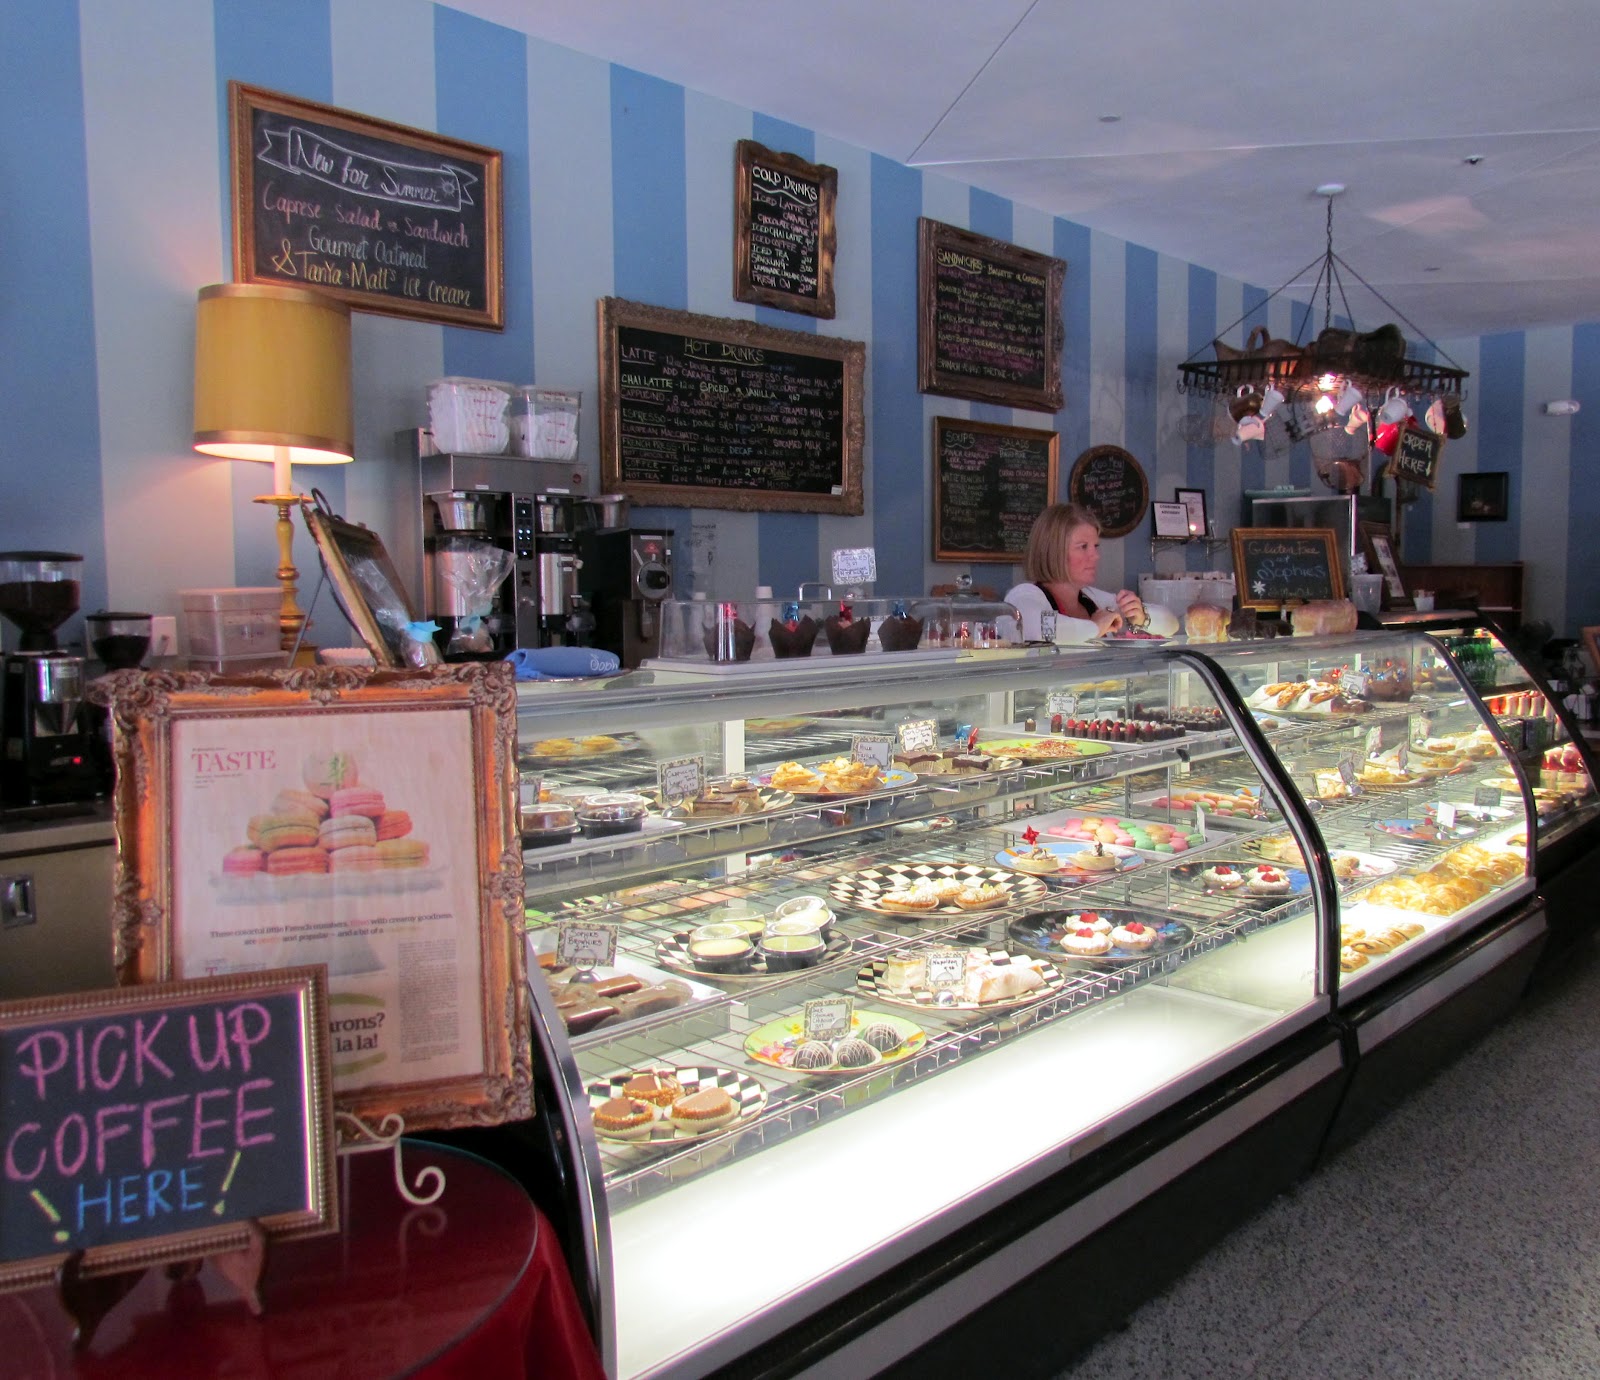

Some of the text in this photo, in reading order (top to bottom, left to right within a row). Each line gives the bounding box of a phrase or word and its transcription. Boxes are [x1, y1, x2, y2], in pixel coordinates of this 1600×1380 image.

[296, 135, 441, 203] New for Summer
[752, 165, 819, 202] COLD DRINKS
[752, 191, 777, 207] ICED
[779, 196, 806, 214] LATTE
[263, 181, 322, 225] Caprese
[336, 205, 383, 232] Salad
[404, 217, 470, 248] Sandwich
[752, 222, 803, 245] ICED CHAI LATTE
[752, 233, 771, 246] ICED
[771, 239, 798, 254] COFFEE
[309, 225, 429, 270] Gourmet Oatmeal
[752, 243, 772, 256] ICED
[775, 248, 790, 262] TEA
[752, 270, 777, 288] FRESH
[428, 280, 471, 307] Cream
[684, 338, 765, 364] HOT DRINKS
[621, 344, 657, 362] LATTE
[719, 366, 737, 377] SHOT
[741, 369, 781, 384] ESPRESSO
[662, 367, 679, 377] ADD
[681, 369, 718, 384] CARAMEL
[621, 374, 643, 387] CHAI
[644, 377, 673, 390] LATTE
[699, 380, 730, 394] SPICED
[745, 387, 779, 400] VANILLA
[622, 407, 667, 424] ESPRESSO
[622, 437, 651, 449] FRENCH
[652, 440, 678, 452] PRESS
[729, 446, 753, 456] DECAF
[945, 430, 977, 445] SOUPS
[1403, 432, 1434, 459] ORDER
[624, 458, 660, 470] COFFEE
[1398, 450, 1425, 475] HERE
[624, 471, 641, 481] HOT
[643, 472, 660, 481] TEA
[1248, 541, 1321, 556] Gluten Free
[191, 749, 278, 773] TASTE
[337, 930, 352, 938] and
[15, 1001, 272, 1102] PICK UP
[335, 1033, 379, 1052] la la!
[4, 1078, 276, 1182] COFFEE
